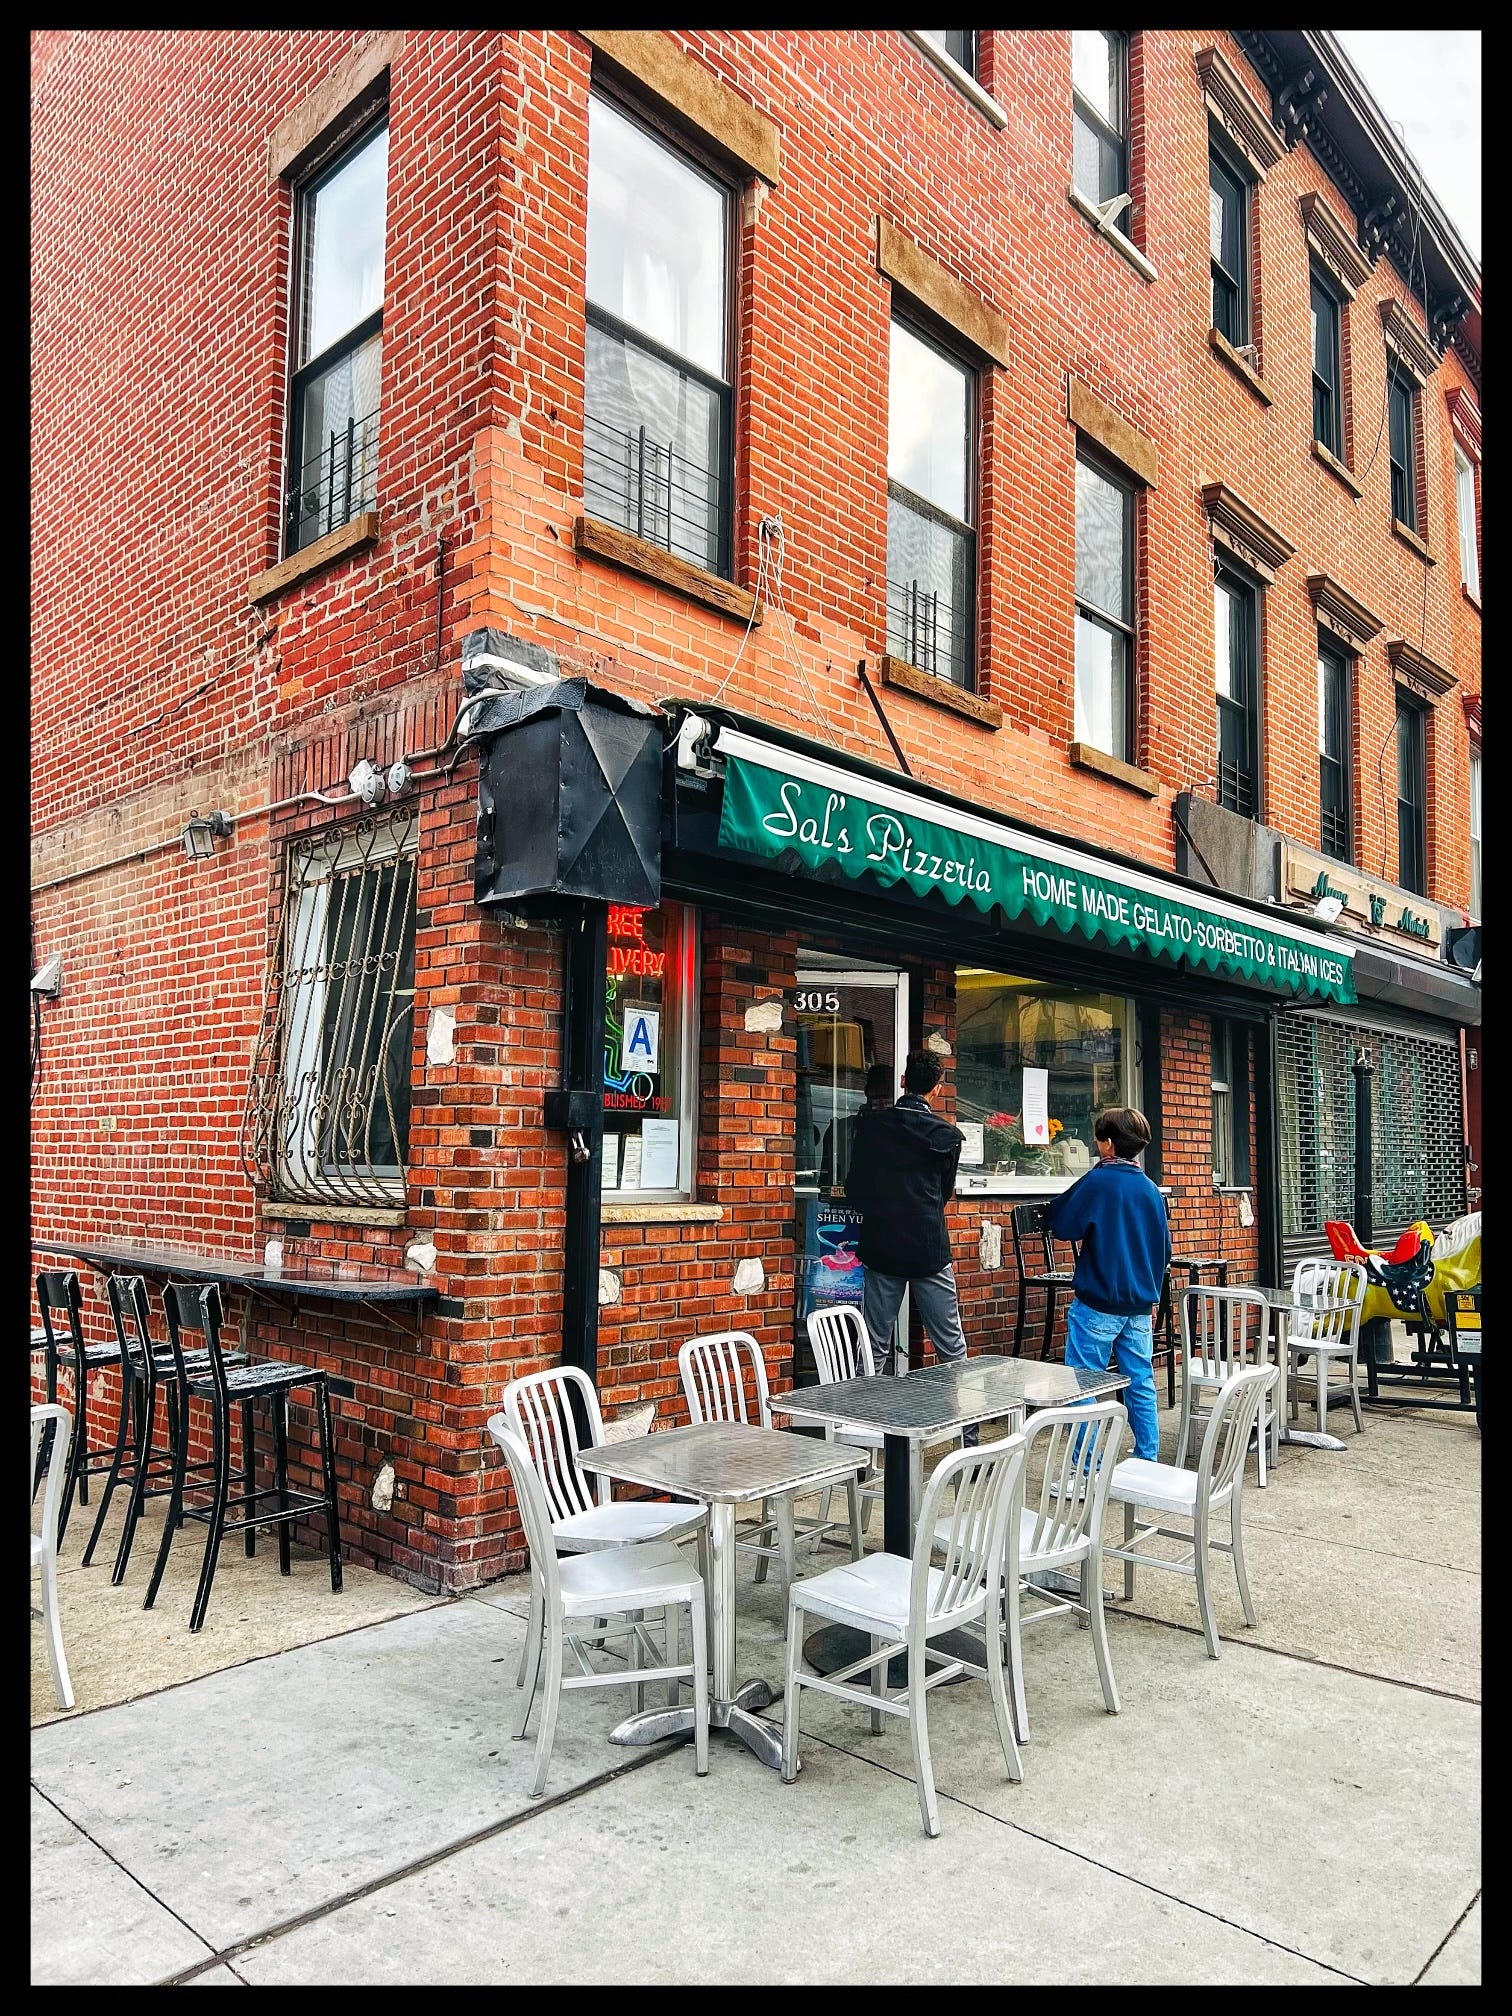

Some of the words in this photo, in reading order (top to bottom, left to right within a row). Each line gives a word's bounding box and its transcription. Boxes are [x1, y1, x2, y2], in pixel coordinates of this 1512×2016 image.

[762, 782, 853, 853] Sal's
[866, 814, 992, 893] Pizzeria
[607, 913, 643, 937] REE
[1023, 866, 1077, 909] HOME
[1082, 885, 1129, 925] MADE
[1267, 943, 1275, 966] &
[1278, 946, 1317, 977] ITALIAN
[1320, 960, 1343, 985] ICES
[606, 947, 665, 976] IVERY
[793, 991, 840, 1012] 305
[629, 1017, 652, 1055] A
[604, 1093, 646, 1110] BLISHED
[817, 1213, 846, 1223] SHEN
[849, 1215, 864, 1224] YU
